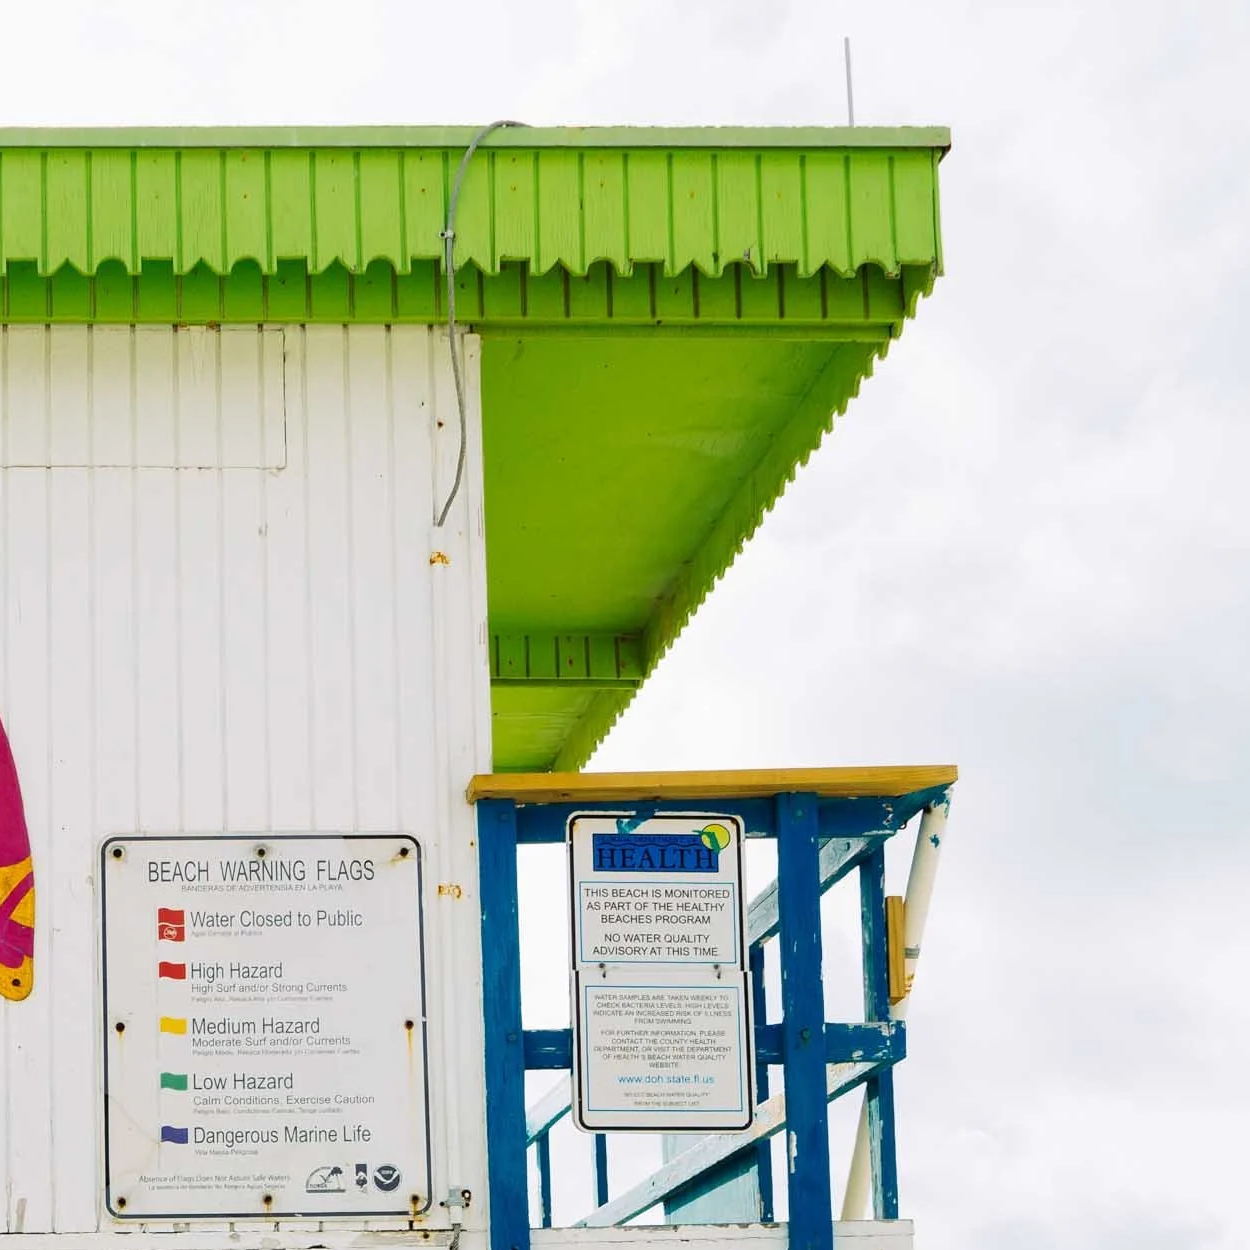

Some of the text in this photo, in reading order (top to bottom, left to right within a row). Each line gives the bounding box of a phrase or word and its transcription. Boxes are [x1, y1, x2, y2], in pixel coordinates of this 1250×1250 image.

[598, 848, 716, 869] HEALTH
[148, 860, 375, 882] BEACH WARNING FLAGS
[585, 888, 730, 898] THIS BEACH IS MONITORED
[586, 902, 724, 911] AS PART OF THE HEALTHY
[190, 910, 363, 927] Water Closed to Public
[601, 915, 710, 924] BEACHES PROGRAM
[605, 934, 709, 943] NO WATER QUALITY
[593, 946, 646, 955] ADVISORY
[650, 947, 662, 955] AT
[666, 947, 689, 955] THIS
[191, 962, 283, 983] High Hazard
[192, 982, 348, 994] High Surf and/or Strong Currents
[192, 1018, 320, 1034] Medium Hazard
[192, 1036, 350, 1047] Moderate Surf and/or Currents
[193, 1073, 293, 1090] Low Hazard
[618, 1074, 715, 1084] www.doh.state.fl.us
[194, 1096, 221, 1105] Calm
[287, 1095, 331, 1105] Exercise
[335, 1095, 374, 1104] Caution
[194, 1125, 371, 1148] Dangerous Marine Life
